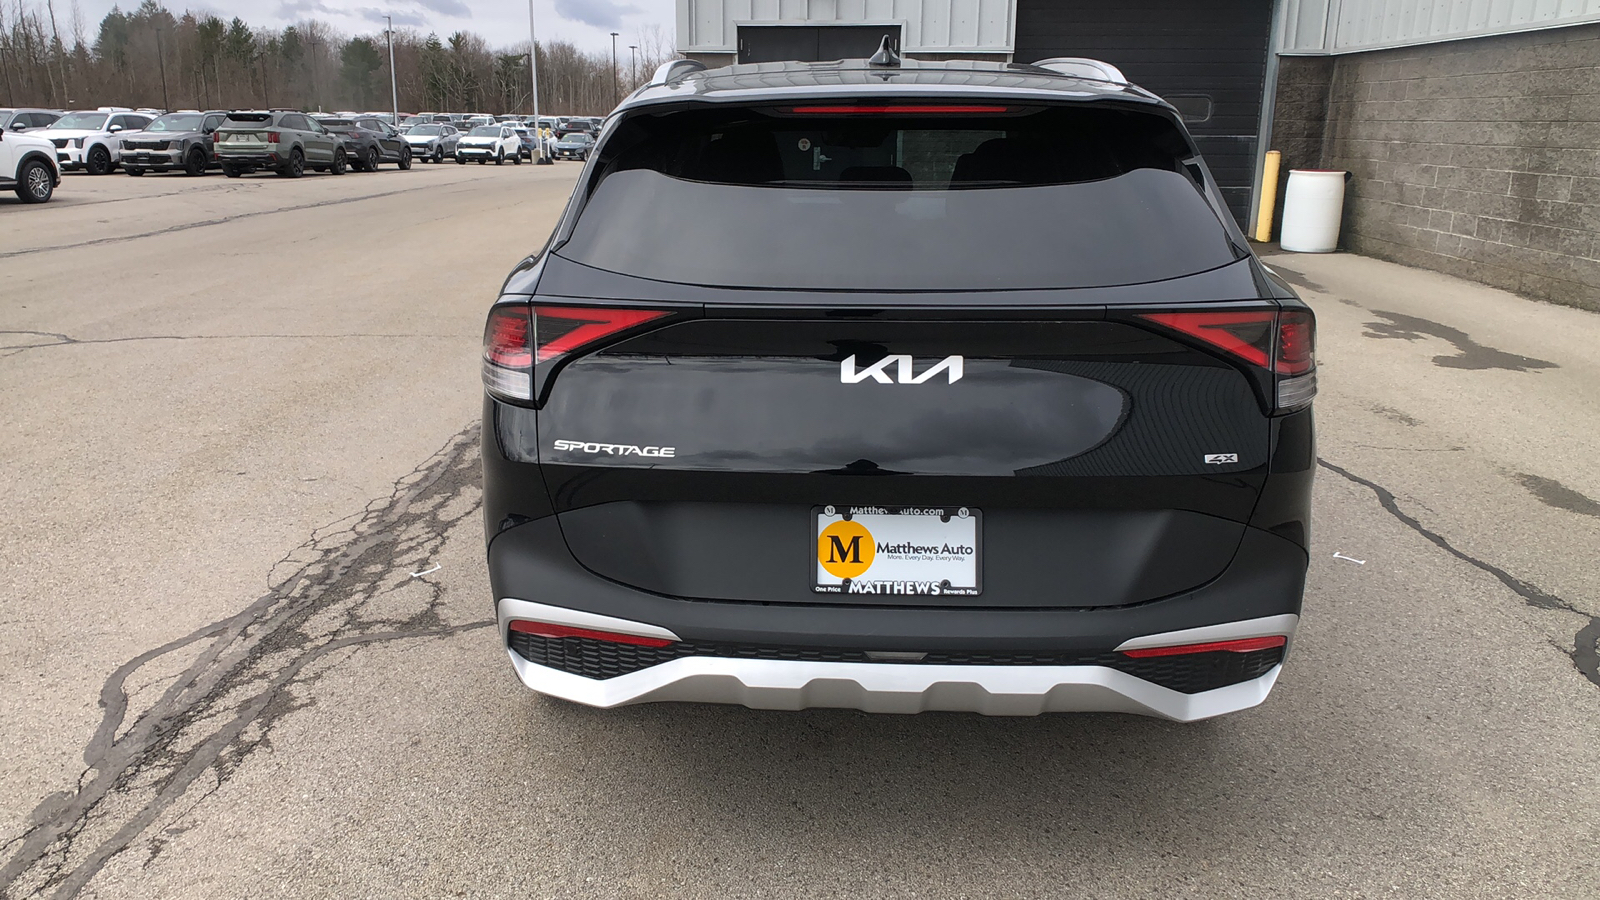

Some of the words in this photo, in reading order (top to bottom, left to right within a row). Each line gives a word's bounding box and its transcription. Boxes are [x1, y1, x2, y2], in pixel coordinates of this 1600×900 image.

[840, 354, 964, 385] KIA
[553, 439, 676, 458] SPORTAGE
[825, 535, 864, 564] M
[876, 541, 939, 555] Matthews
[940, 542, 974, 555] Auto
[904, 554, 921, 562] Every
[935, 554, 952, 562] Every
[848, 580, 941, 596] MATTHEWS
